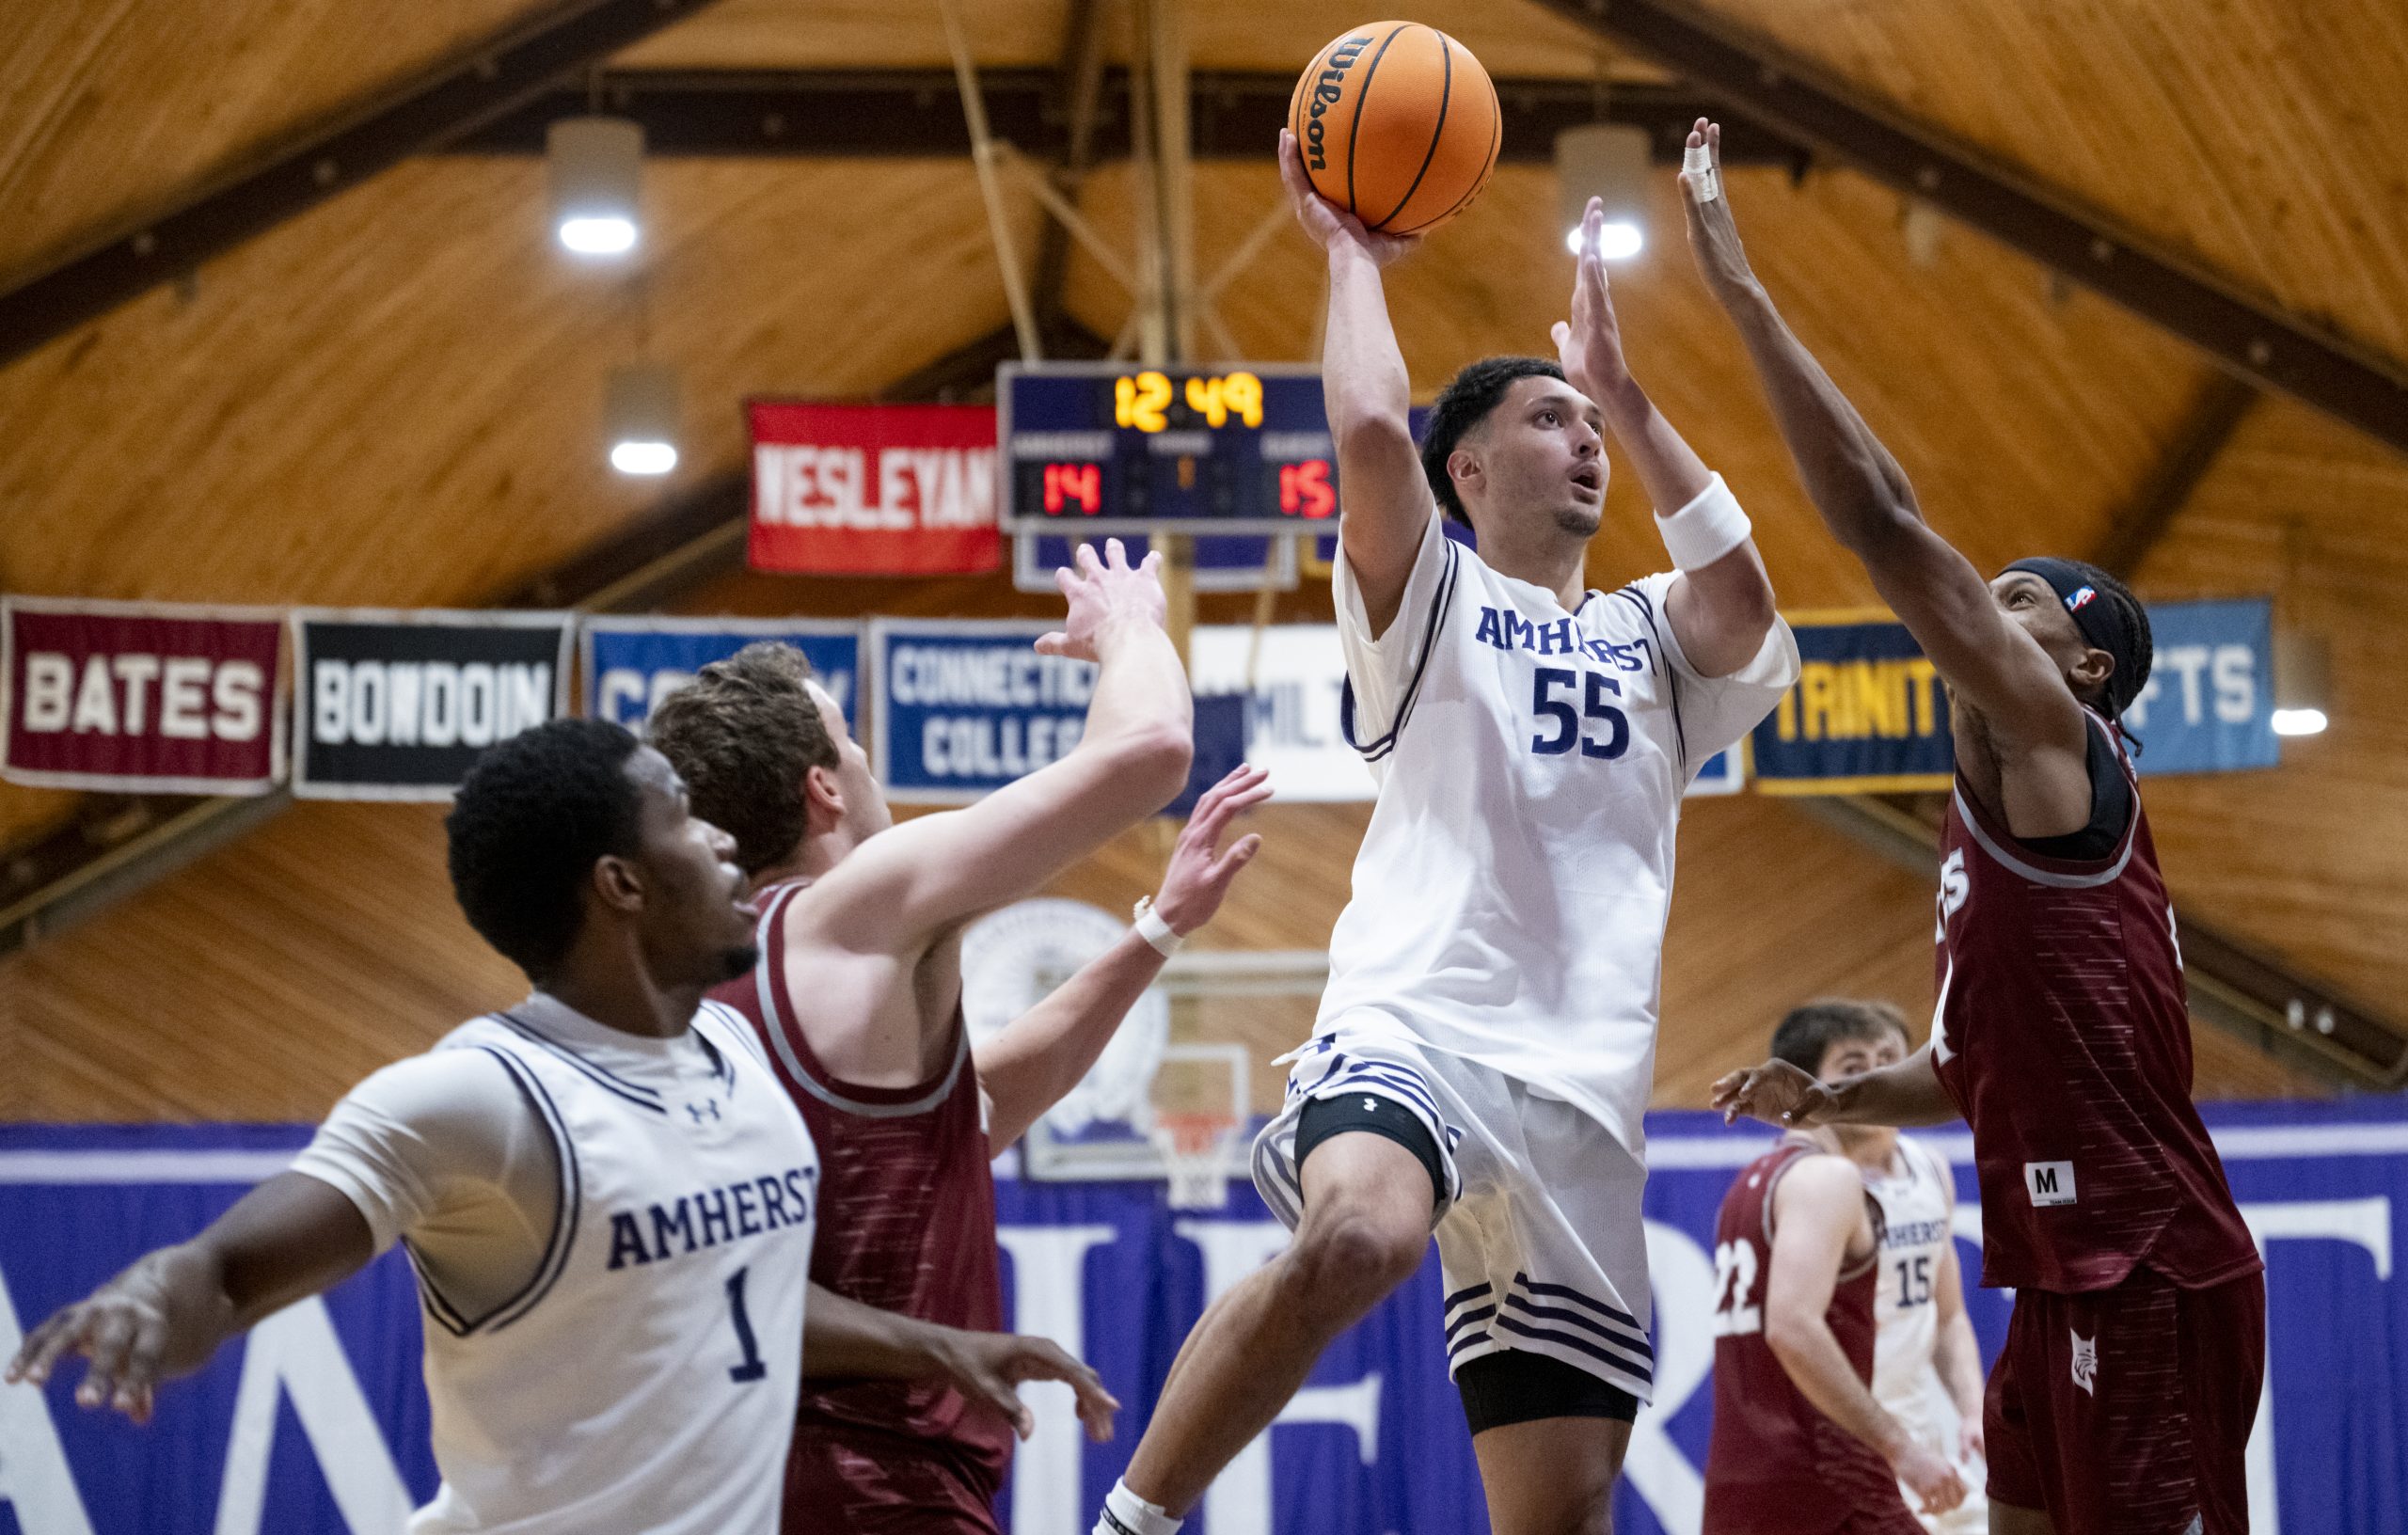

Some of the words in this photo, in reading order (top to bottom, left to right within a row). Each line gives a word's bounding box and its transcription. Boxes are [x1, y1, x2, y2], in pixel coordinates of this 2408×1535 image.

[1307, 36, 1375, 171] Wilson
[1044, 463, 1101, 515] 14
[1279, 459, 1337, 519] 15
[24, 651, 265, 742] BATES
[312, 659, 554, 748] BOWDOIN
[1531, 667, 1629, 760] 55
[2035, 1167, 2058, 1195] M
[725, 1265, 767, 1383] 1
[1896, 1255, 1932, 1308] 15
